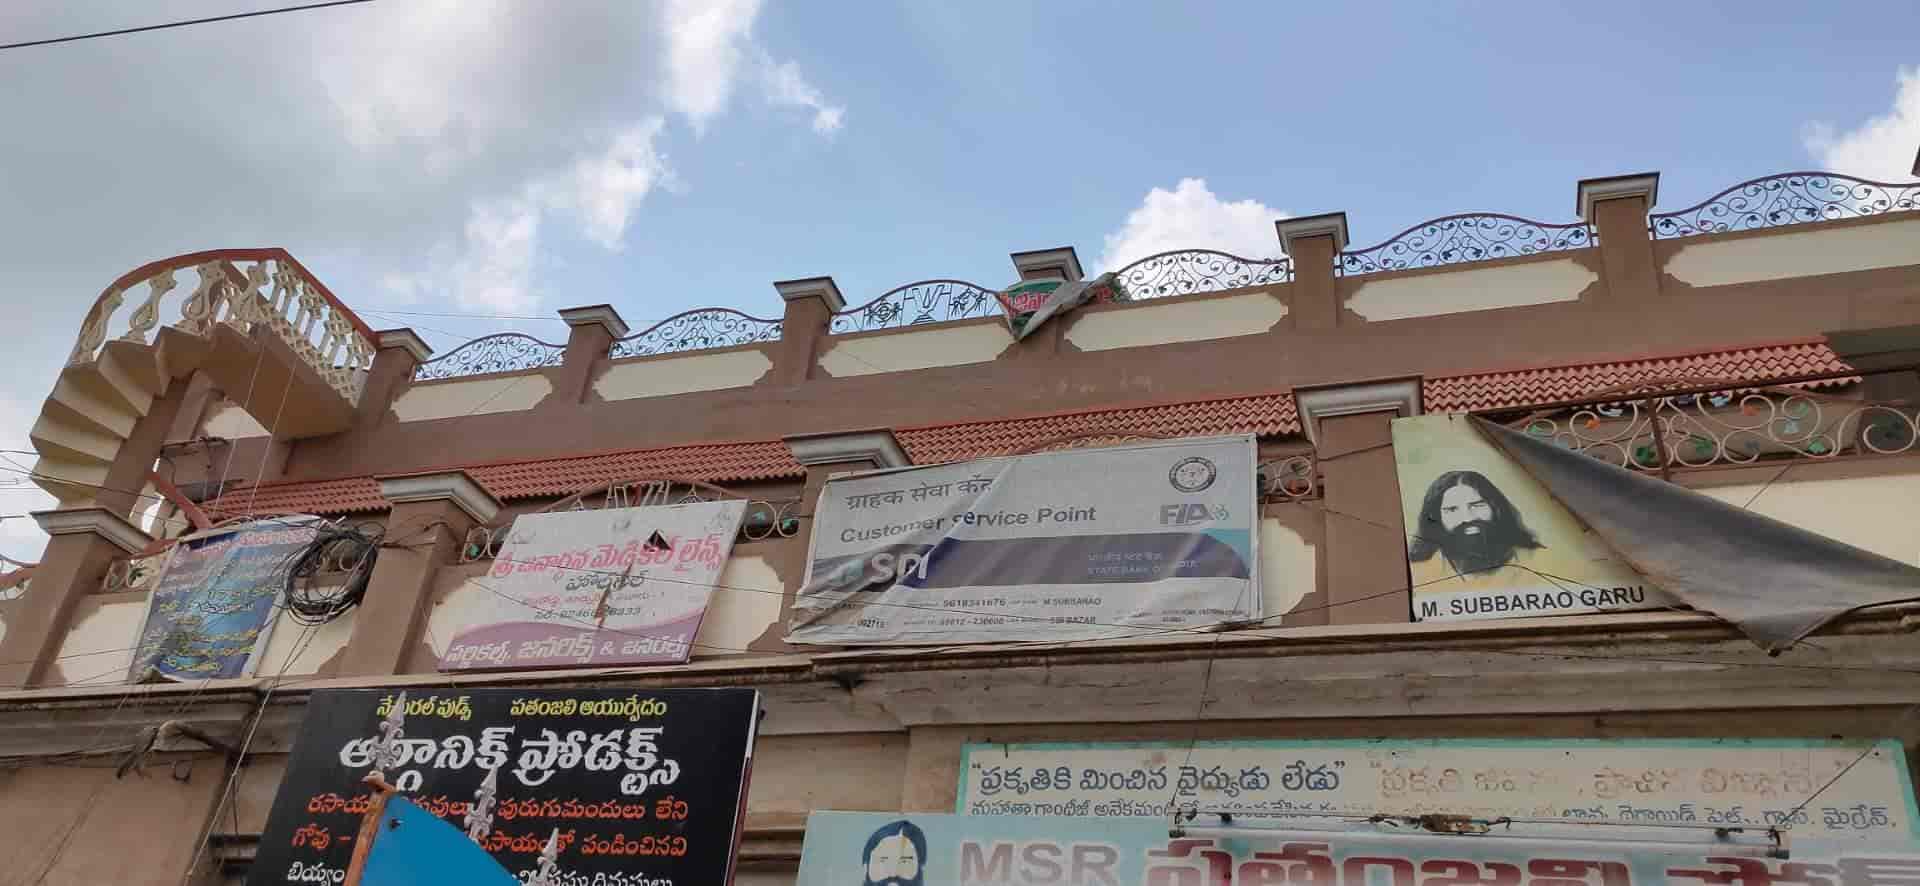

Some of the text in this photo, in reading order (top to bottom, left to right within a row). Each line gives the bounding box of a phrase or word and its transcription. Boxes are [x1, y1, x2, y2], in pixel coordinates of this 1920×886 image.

[845, 489, 904, 510] ग्राहक
[910, 482, 952, 502] सेवा
[840, 516, 944, 543] Customer
[1037, 506, 1096, 523] Point
[1421, 586, 1644, 618] M. SUBBARAO GARU
[599, 640, 615, 657] &
[510, 694, 667, 721] పతంజలి ఆయుర్వేదం
[1079, 765, 1168, 791] మించిన
[1176, 765, 1270, 798] వైద్యుడు
[498, 797, 646, 820] పురుగుమందులు
[655, 794, 689, 820] లేని
[581, 832, 688, 857] పండించినవి
[962, 842, 1118, 886] MSR
